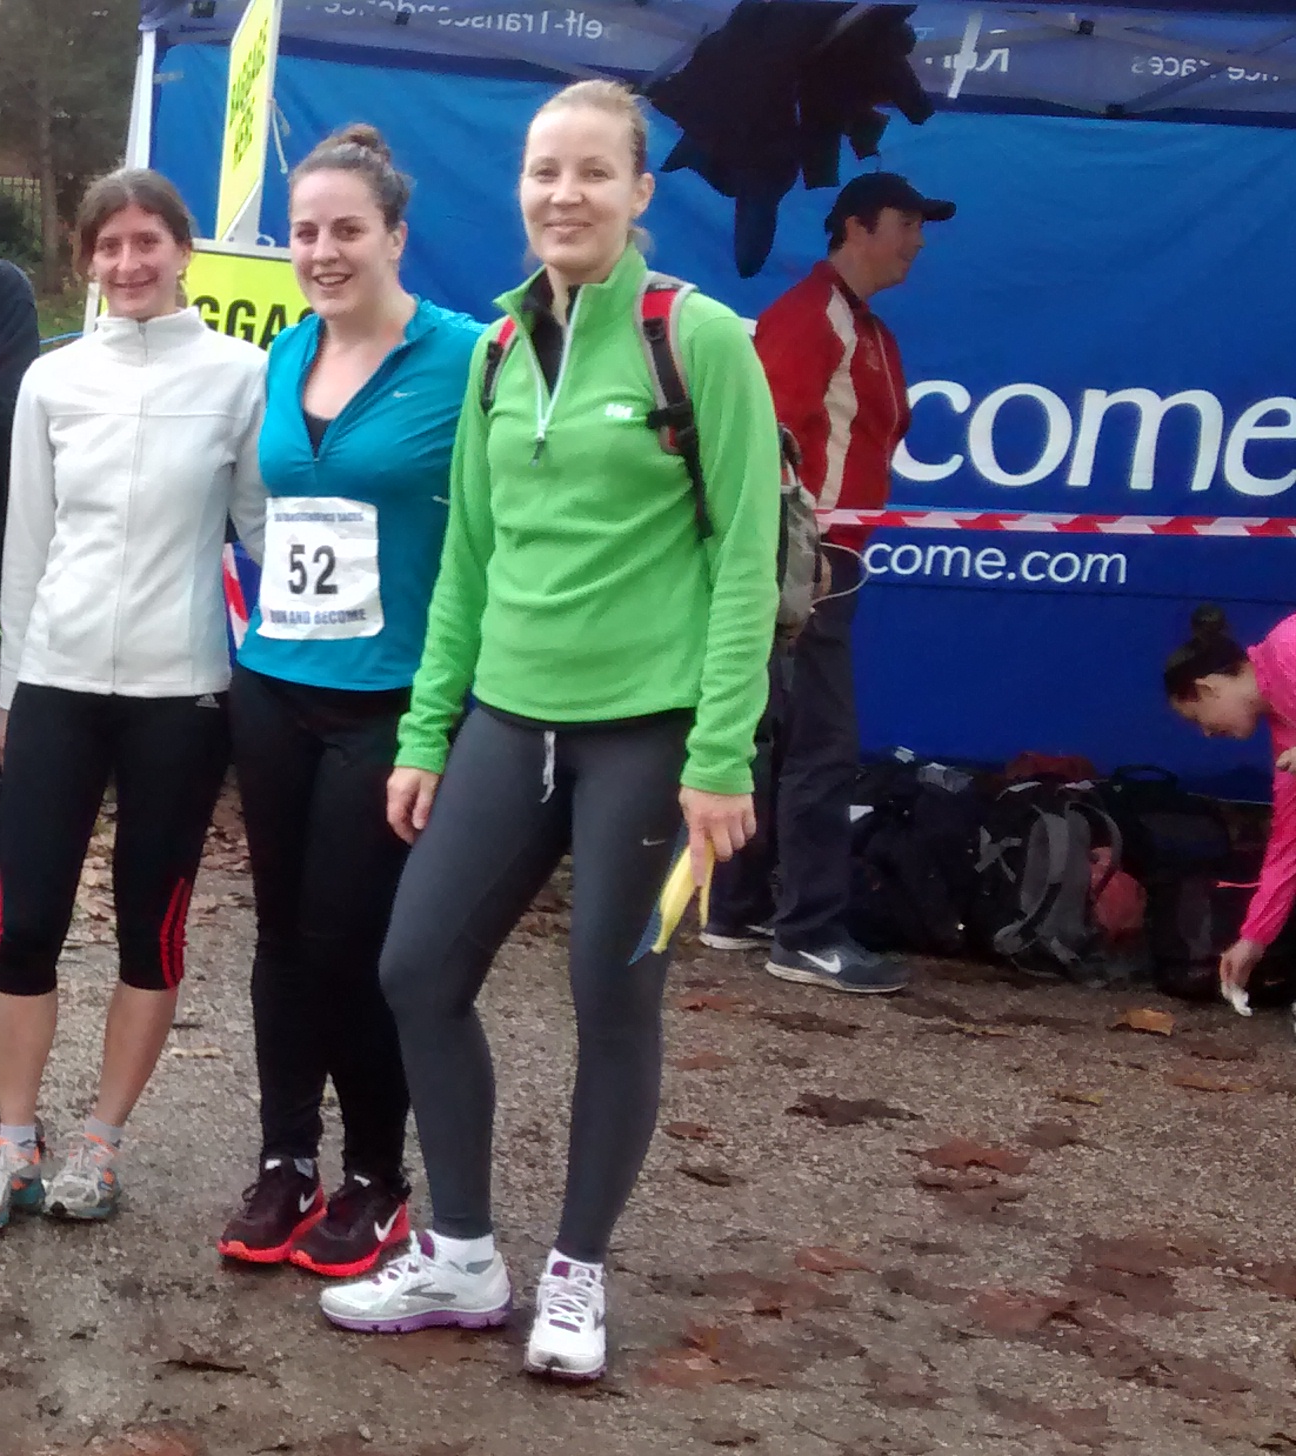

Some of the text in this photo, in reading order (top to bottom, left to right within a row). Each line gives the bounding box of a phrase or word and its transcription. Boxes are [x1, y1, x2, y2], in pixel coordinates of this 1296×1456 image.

[192, 295, 314, 352] GGA
[891, 379, 1296, 497] come
[288, 544, 339, 595] 52
[864, 541, 1128, 585] come.com
